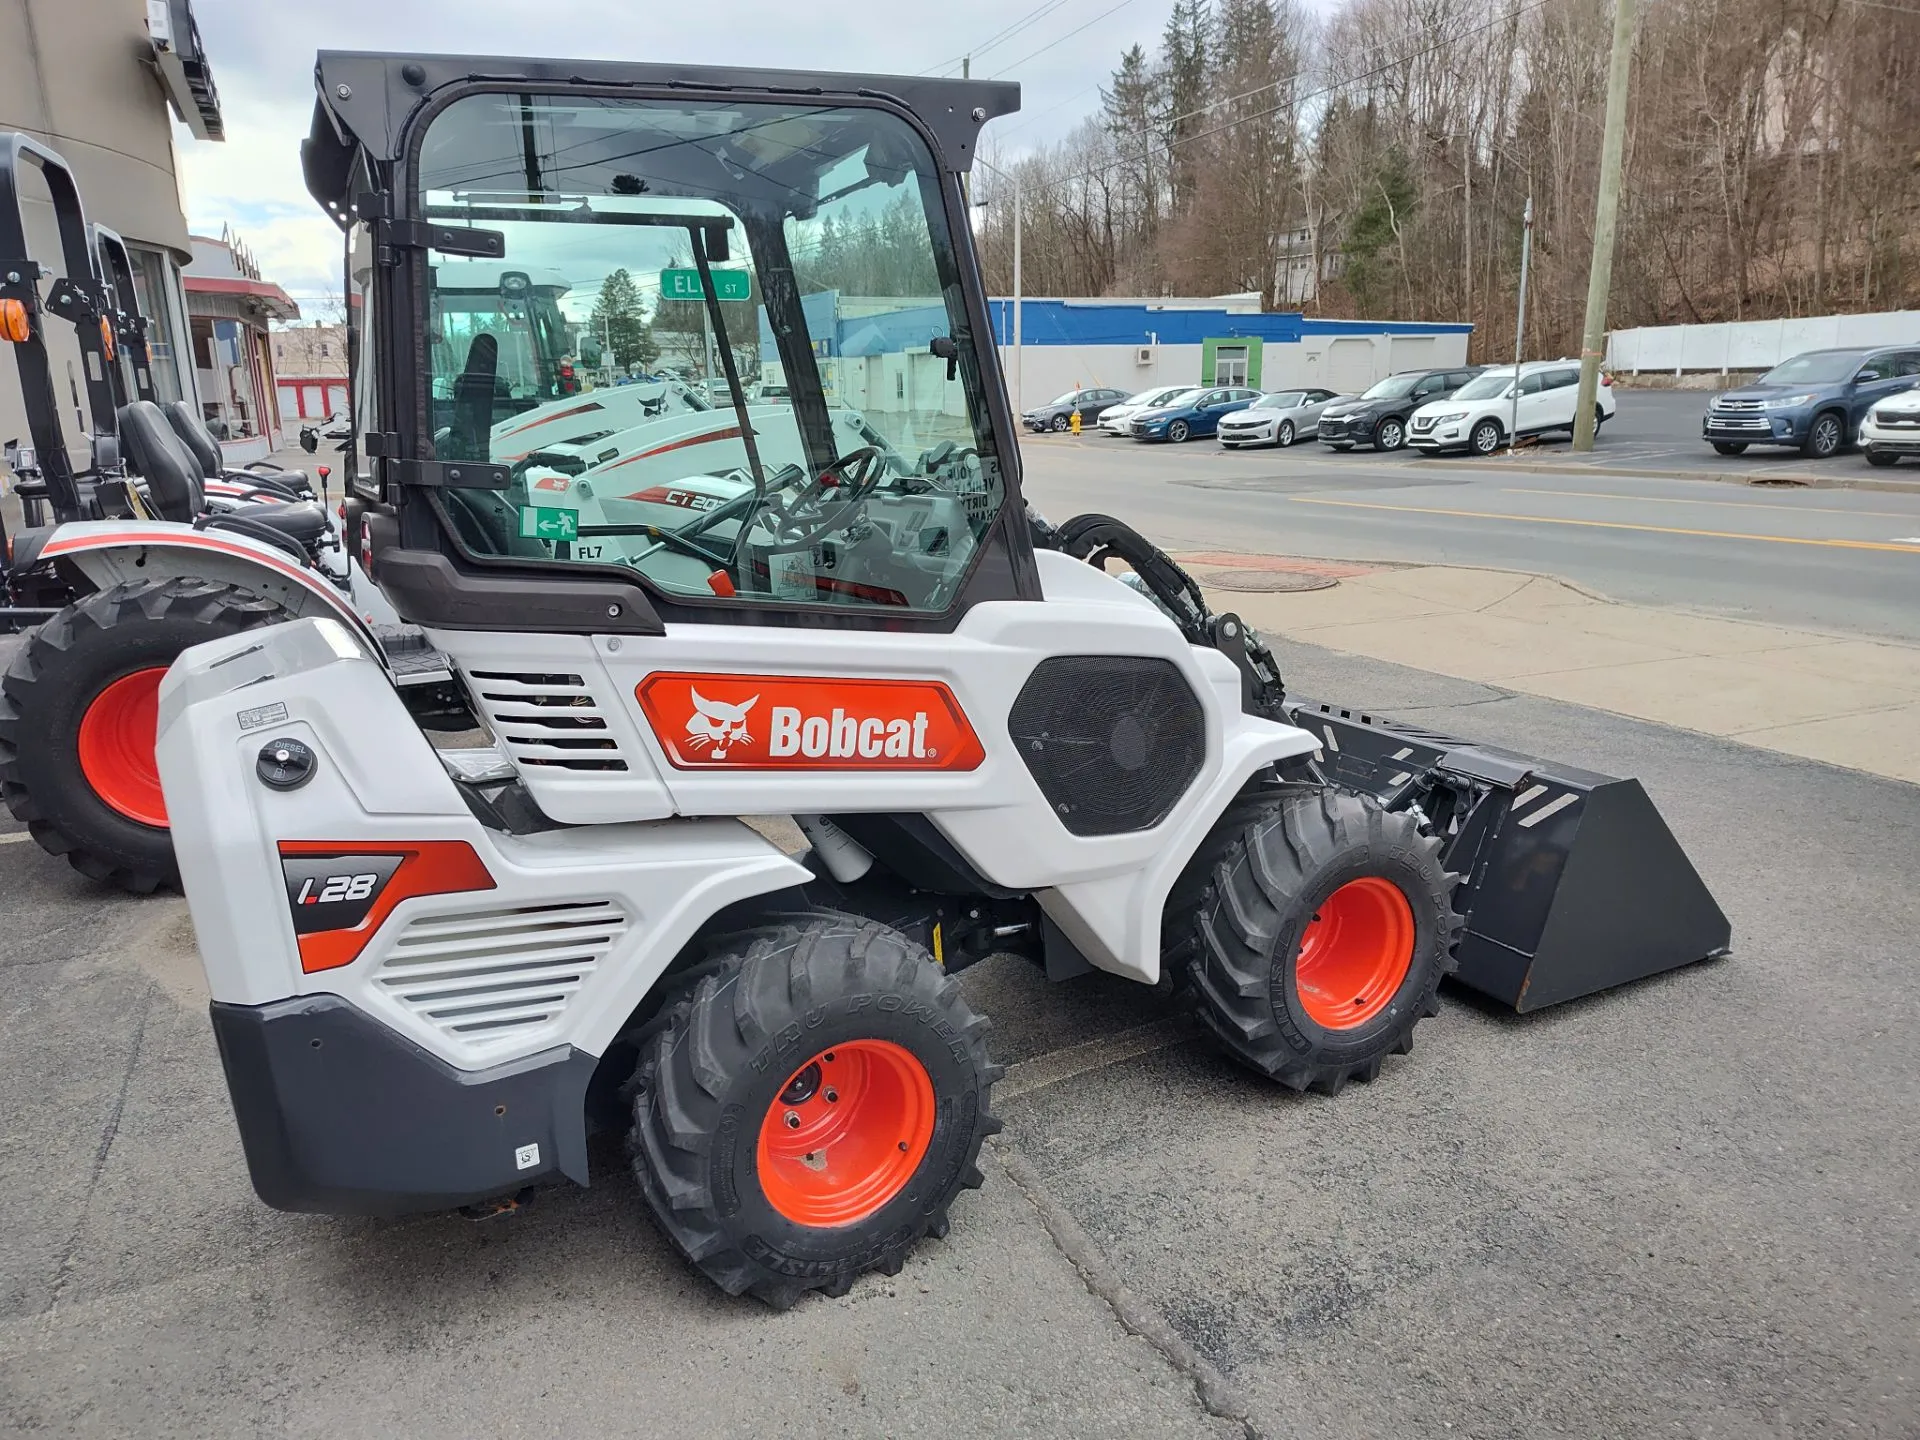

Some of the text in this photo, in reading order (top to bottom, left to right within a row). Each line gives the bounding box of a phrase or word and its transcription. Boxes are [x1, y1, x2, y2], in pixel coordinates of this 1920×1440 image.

[674, 275, 737, 294] EL ST
[578, 546, 602, 559] FL7
[769, 706, 929, 759] Bobcat
[274, 741, 307, 754] DIESEL
[1388, 845, 1434, 885] TRU
[750, 993, 970, 1073] TRU POWER
